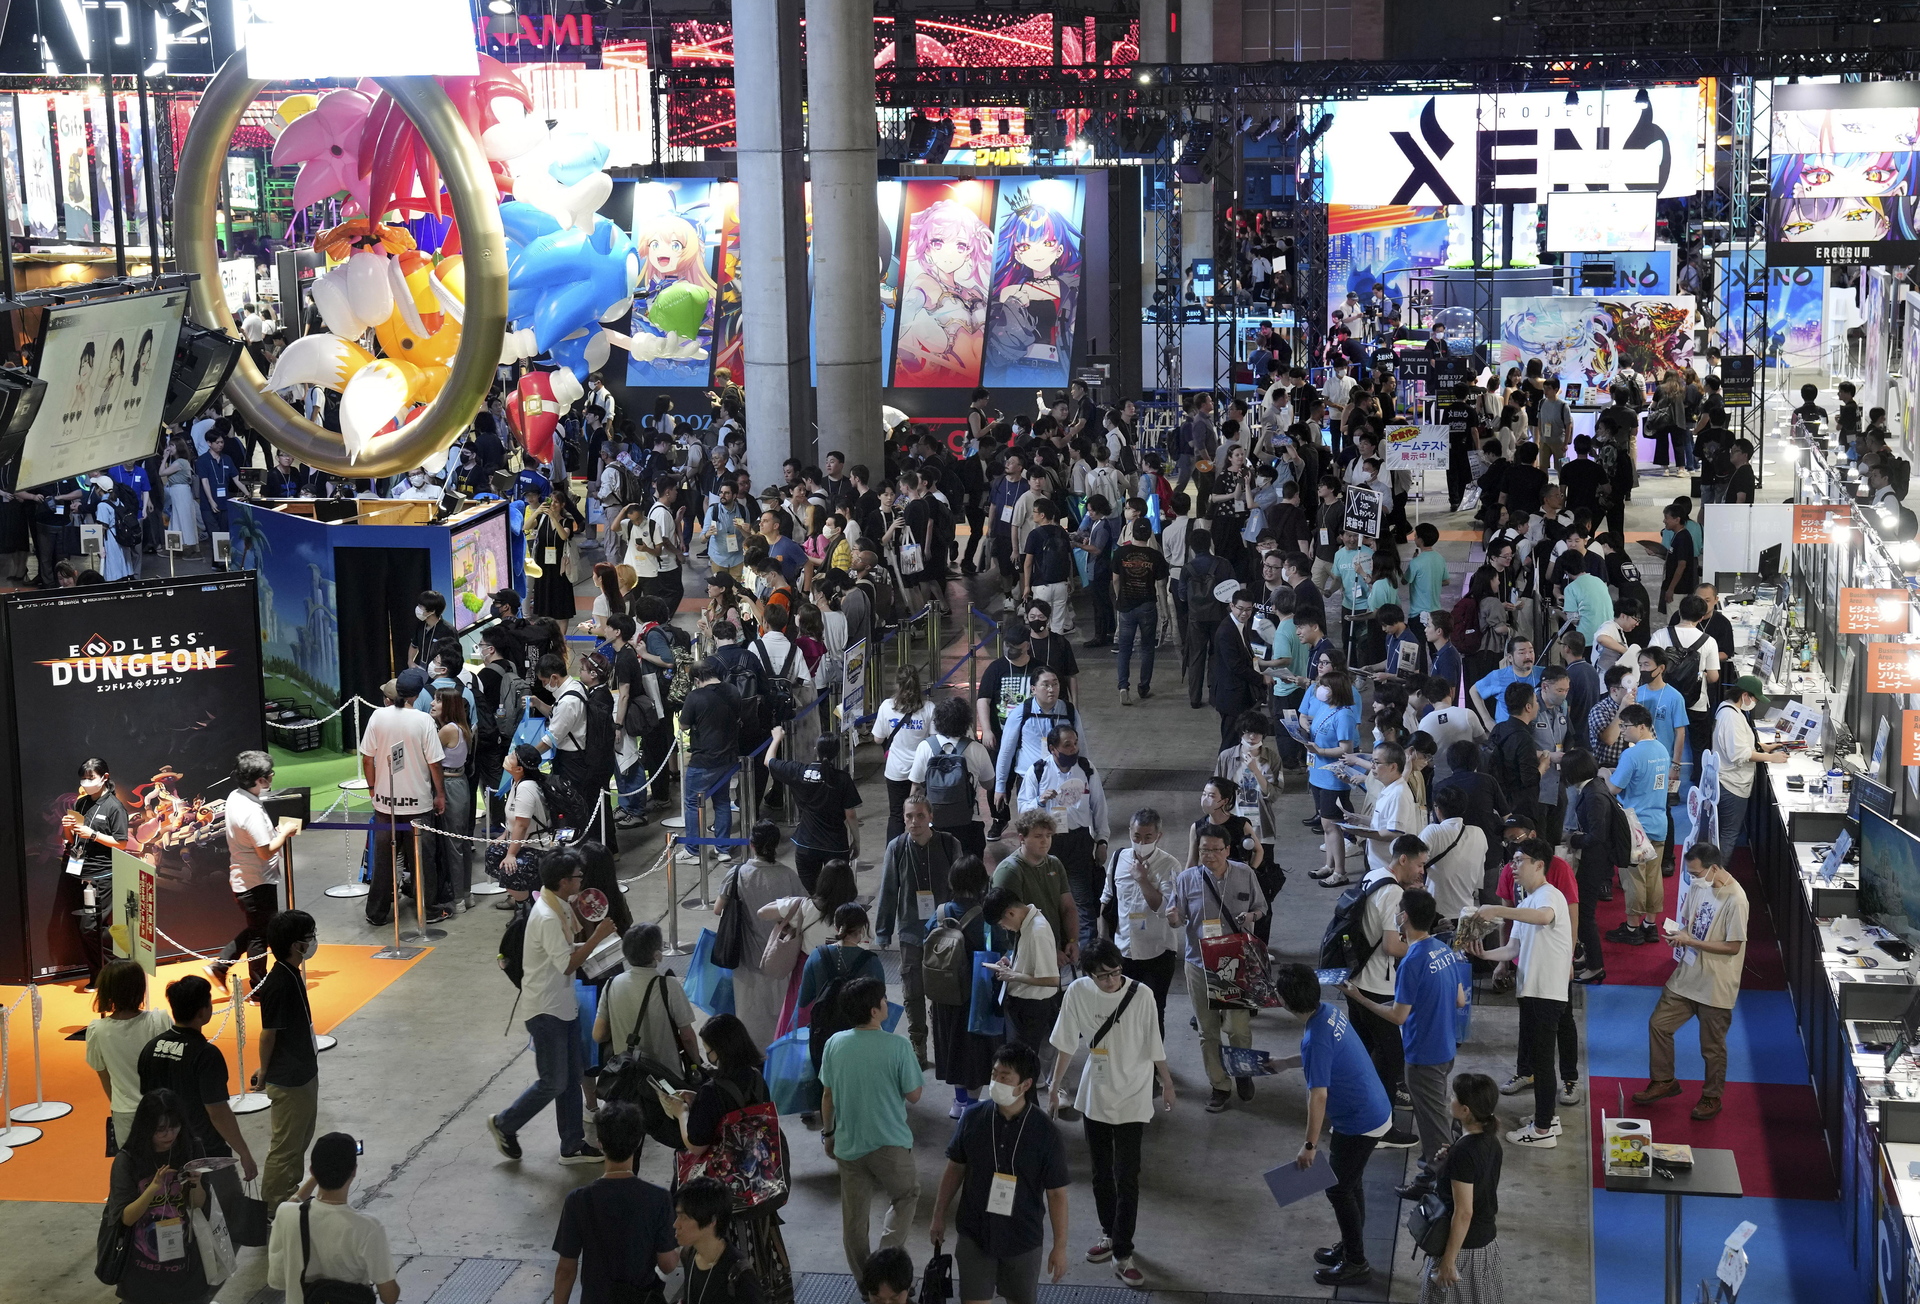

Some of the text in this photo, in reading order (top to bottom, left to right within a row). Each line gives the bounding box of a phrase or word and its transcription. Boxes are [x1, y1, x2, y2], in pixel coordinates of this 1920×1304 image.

[1475, 104, 1611, 119] PROJECT
[1815, 246, 1871, 259] ERGOSUM
[1403, 364, 1427, 375] 入口
[1848, 605, 1880, 613] ビジネス
[51, 645, 217, 686] DUNGEON
[1877, 681, 1912, 689] コーナー
[154, 1039, 184, 1057] SEGA
